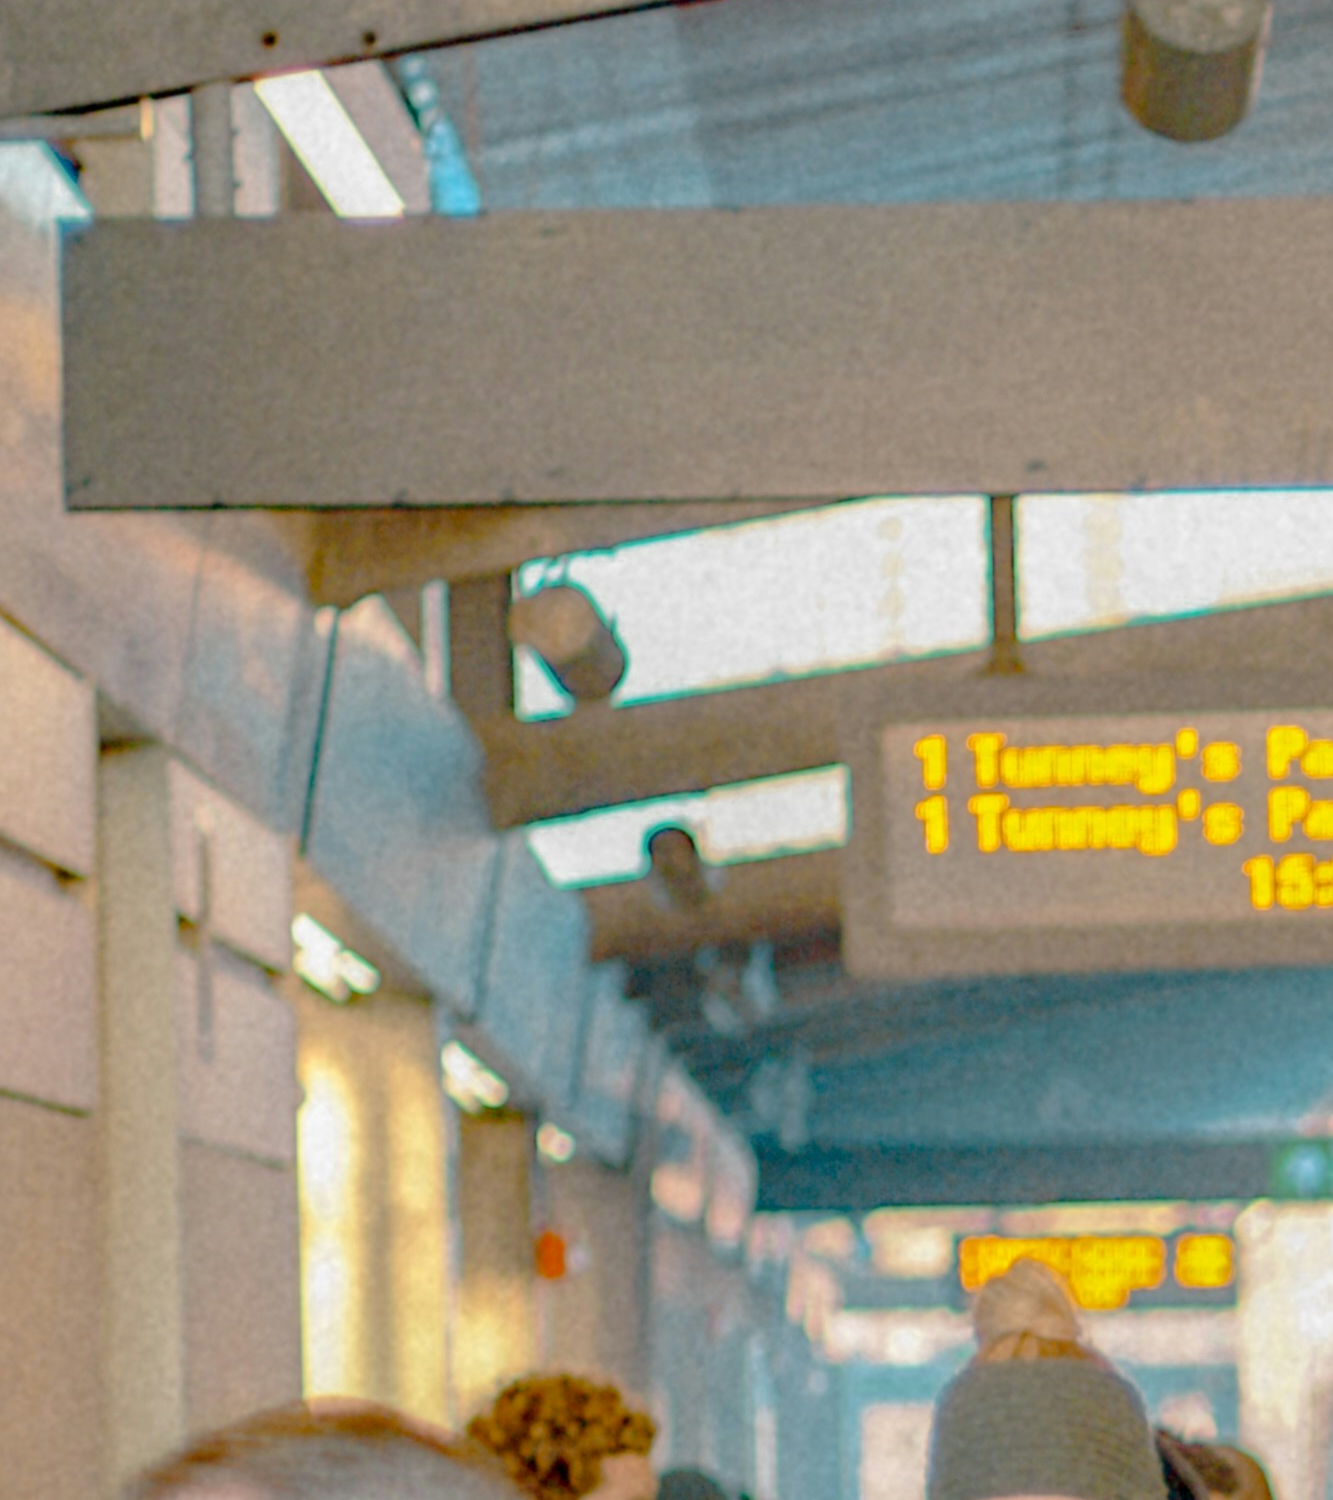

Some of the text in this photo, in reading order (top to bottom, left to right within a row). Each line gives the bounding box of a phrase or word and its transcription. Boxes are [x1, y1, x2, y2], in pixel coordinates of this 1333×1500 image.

[914, 734, 948, 790] 1
[967, 728, 1241, 797] Tunney's
[914, 794, 949, 855] 1
[967, 787, 1244, 857] Tunney's
